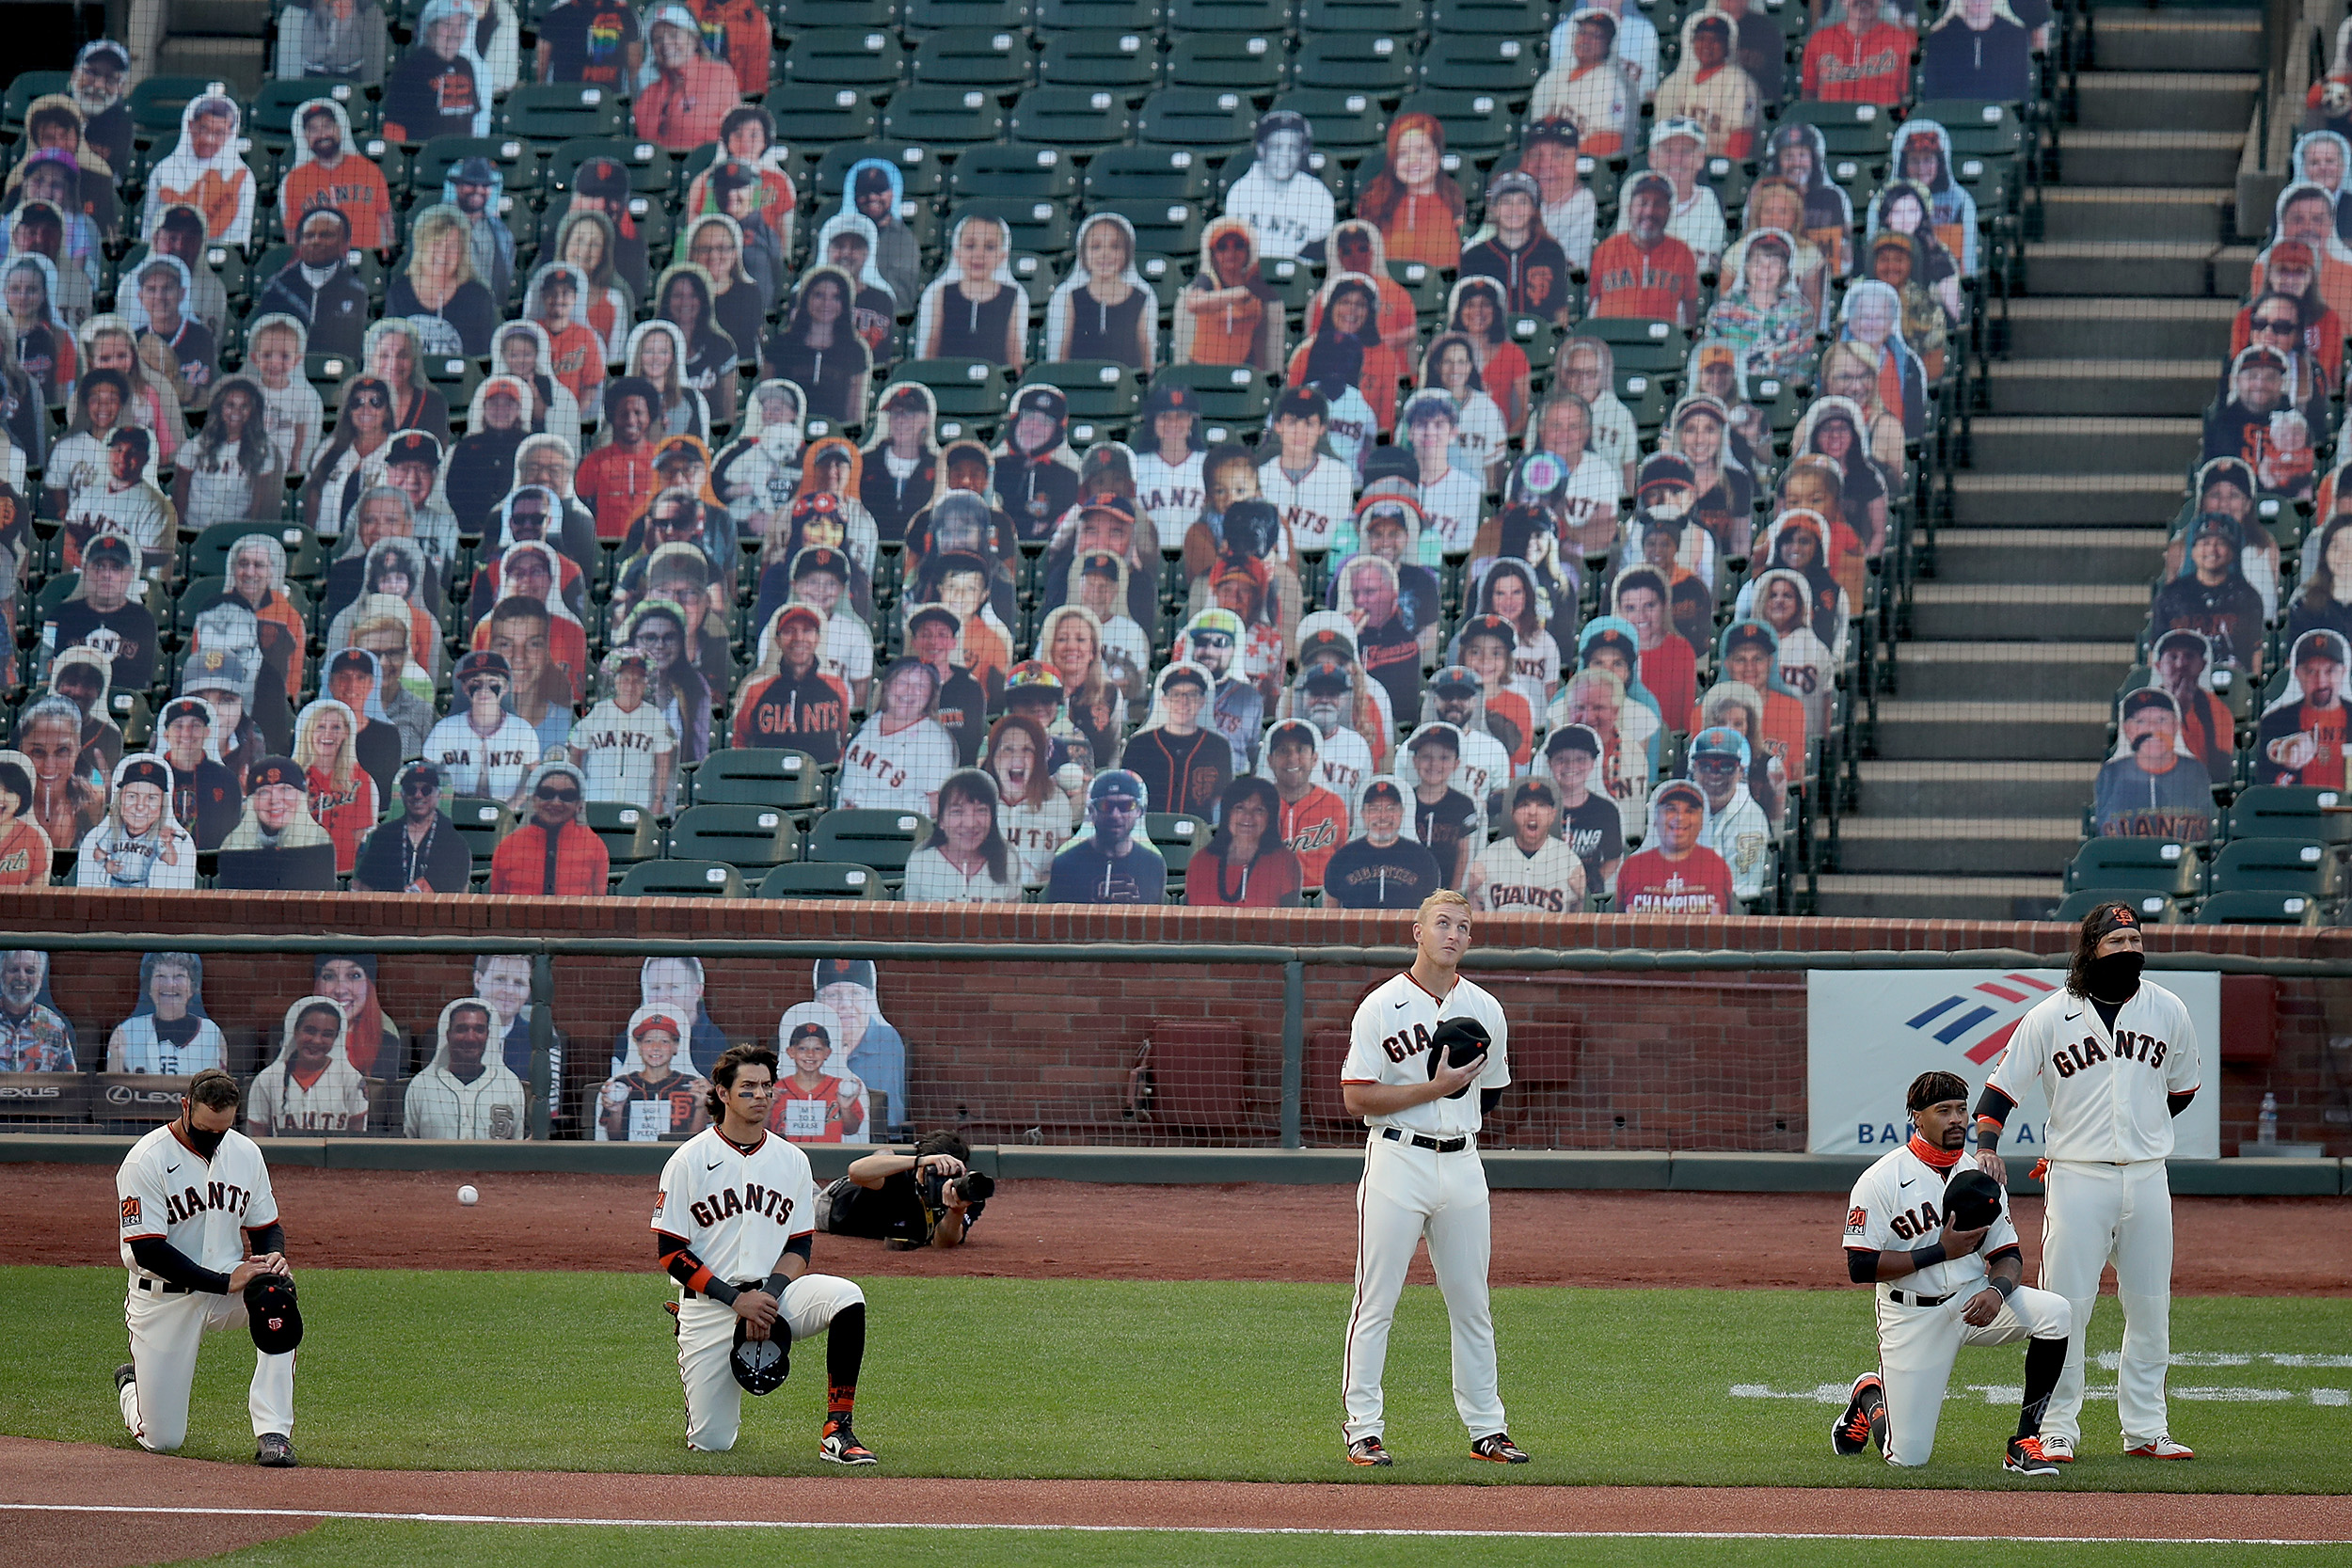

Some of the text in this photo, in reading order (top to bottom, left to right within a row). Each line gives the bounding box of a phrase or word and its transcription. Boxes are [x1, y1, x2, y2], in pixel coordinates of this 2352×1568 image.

[1141, 488, 1204, 511] IANT
[1288, 506, 1328, 534] NTS
[1515, 657, 1546, 679] NTS
[757, 700, 840, 734] GIANTS
[849, 744, 906, 788] ANTS
[1324, 760, 1359, 789] NTS
[1283, 817, 1338, 851] nts
[1490, 883, 1563, 911] GIANTS
[1633, 894, 1716, 913] CHAMPIONS
[1382, 1022, 1434, 1064] GIA
[2052, 1030, 2167, 1079] GIANTS
[0, 1086, 60, 1098] EXUS
[135, 1091, 182, 1103] LEX
[1857, 1123, 1917, 1144] BAN
[122, 1200, 139, 1217] 20
[167, 1180, 251, 1225] GIANTS
[690, 1182, 794, 1228] GIANTS
[1849, 1211, 1866, 1226] 20
[1890, 1200, 1943, 1241] GIA
